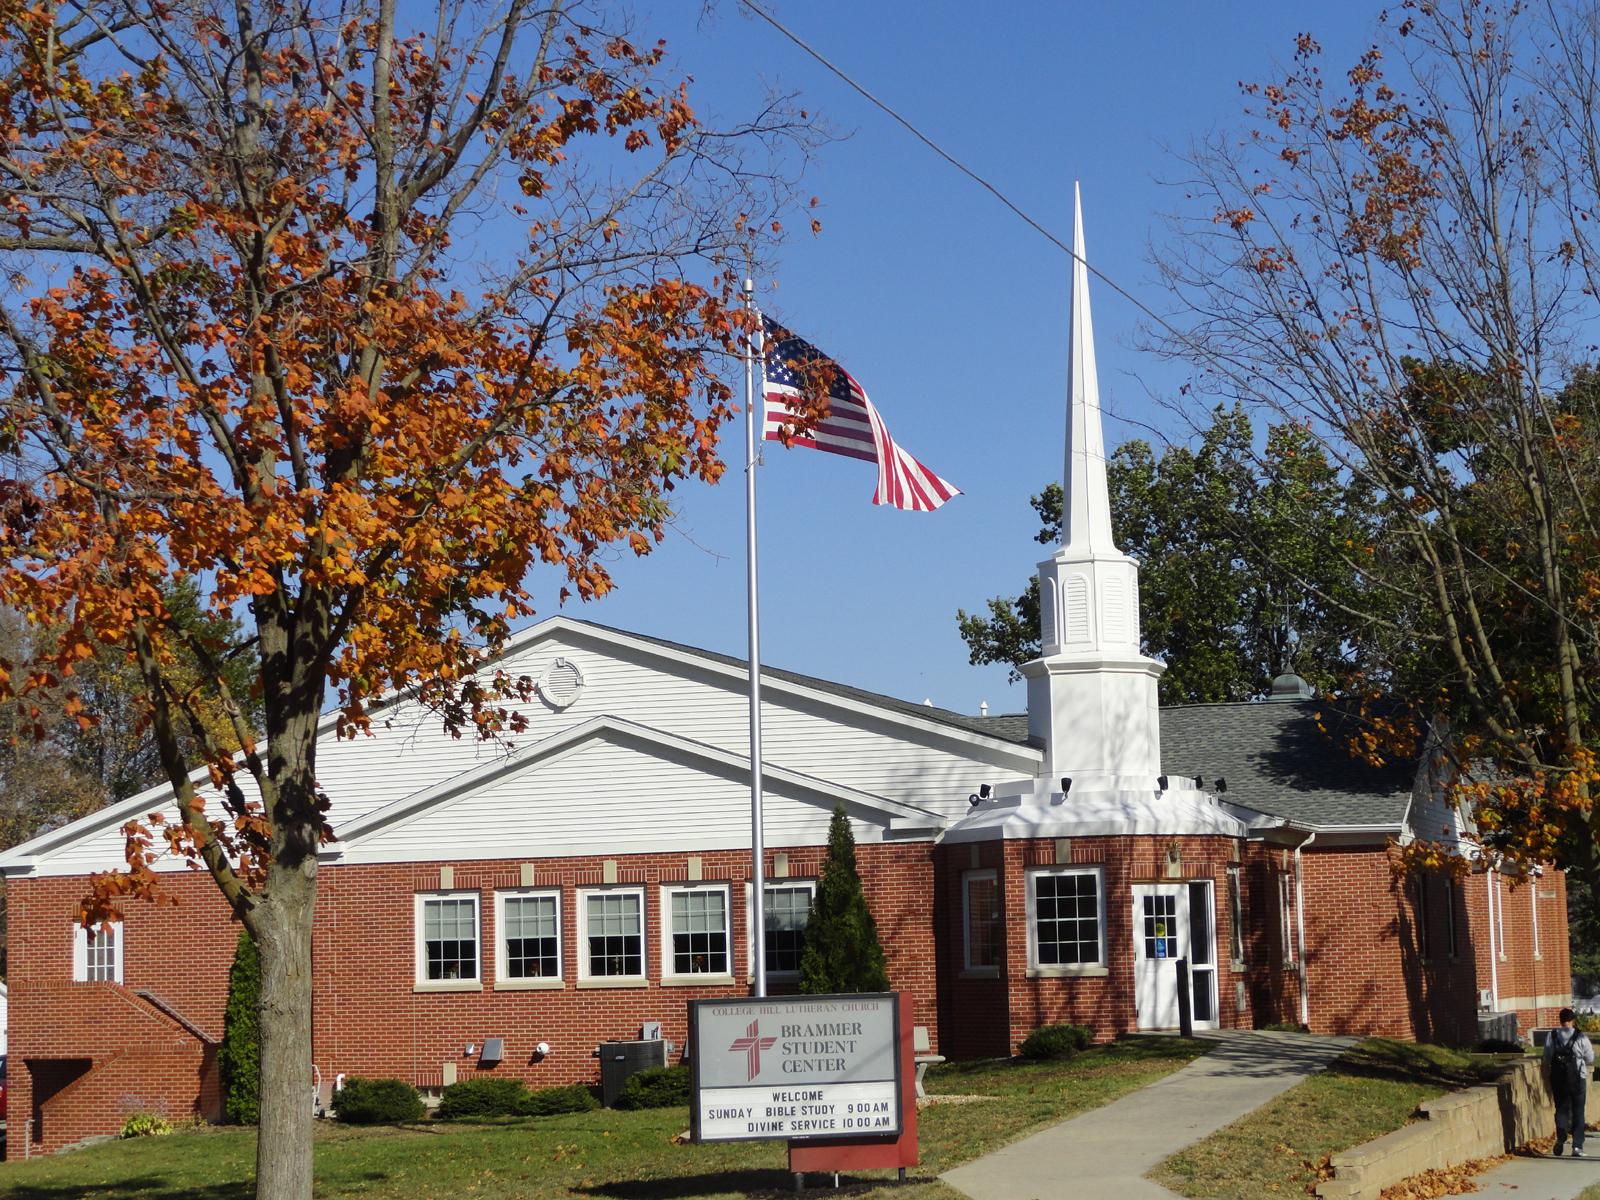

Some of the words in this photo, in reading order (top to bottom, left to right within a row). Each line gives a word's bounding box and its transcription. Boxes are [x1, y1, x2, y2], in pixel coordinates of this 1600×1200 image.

[712, 1007, 755, 1016] COLLEGE
[760, 1006, 781, 1015] HILL
[785, 1004, 837, 1014] LUTHERAN
[842, 1002, 879, 1012] CHURCH
[781, 1022, 862, 1038] BRAMMER
[782, 1040, 857, 1055] STUDENT
[782, 1058, 846, 1073] CENTER
[772, 1090, 823, 1102] WELCOME
[708, 1108, 752, 1119] SUNDAY
[766, 1106, 796, 1117] BIBLE
[801, 1104, 835, 1115] STUDY
[748, 1121, 784, 1132] DIVINE
[791, 1119, 835, 1130] SERVICE
